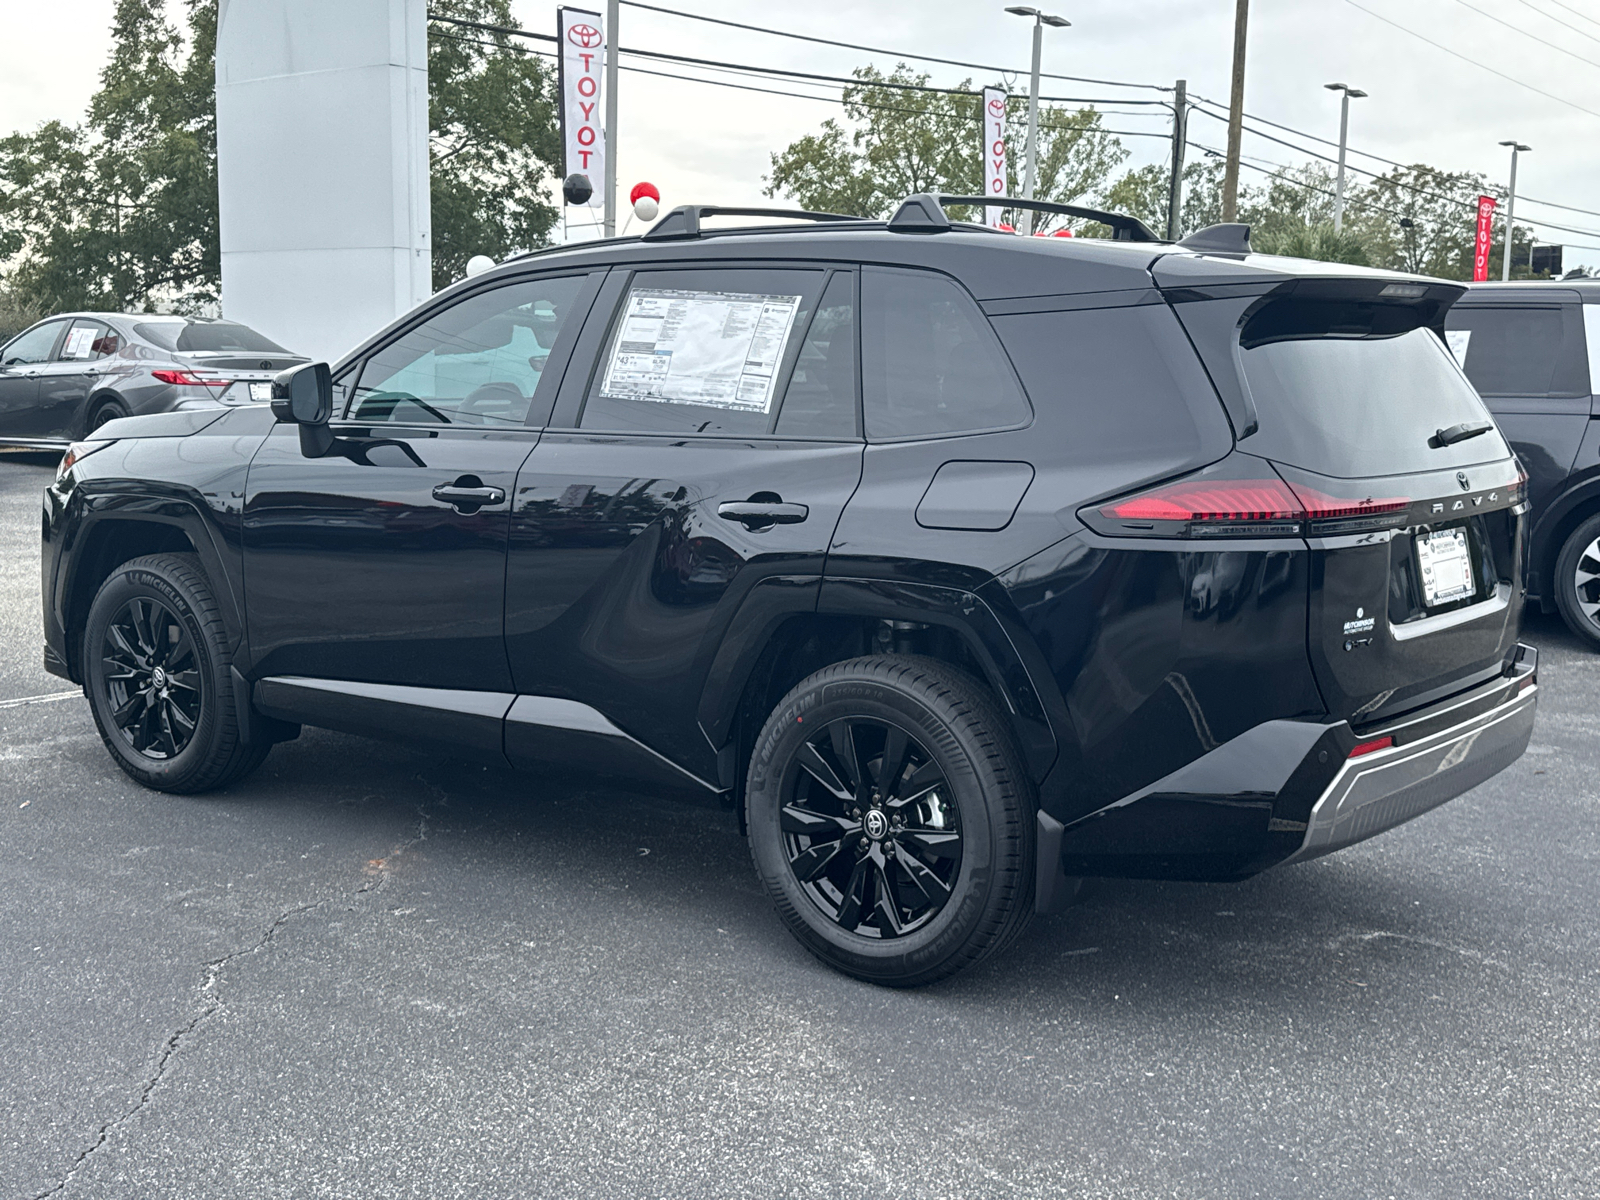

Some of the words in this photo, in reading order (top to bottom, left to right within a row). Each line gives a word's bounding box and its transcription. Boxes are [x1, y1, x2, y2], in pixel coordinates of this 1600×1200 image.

[577, 53, 597, 190] TOYOT
[992, 122, 1004, 214] TOYO
[1477, 218, 1488, 280] TOYOT
[1430, 491, 1499, 514] RAV4
[140, 574, 187, 611] MICHELIN
[831, 686, 863, 697] 235/60
[864, 688, 871, 696] R
[761, 692, 816, 761] MICHELIN
